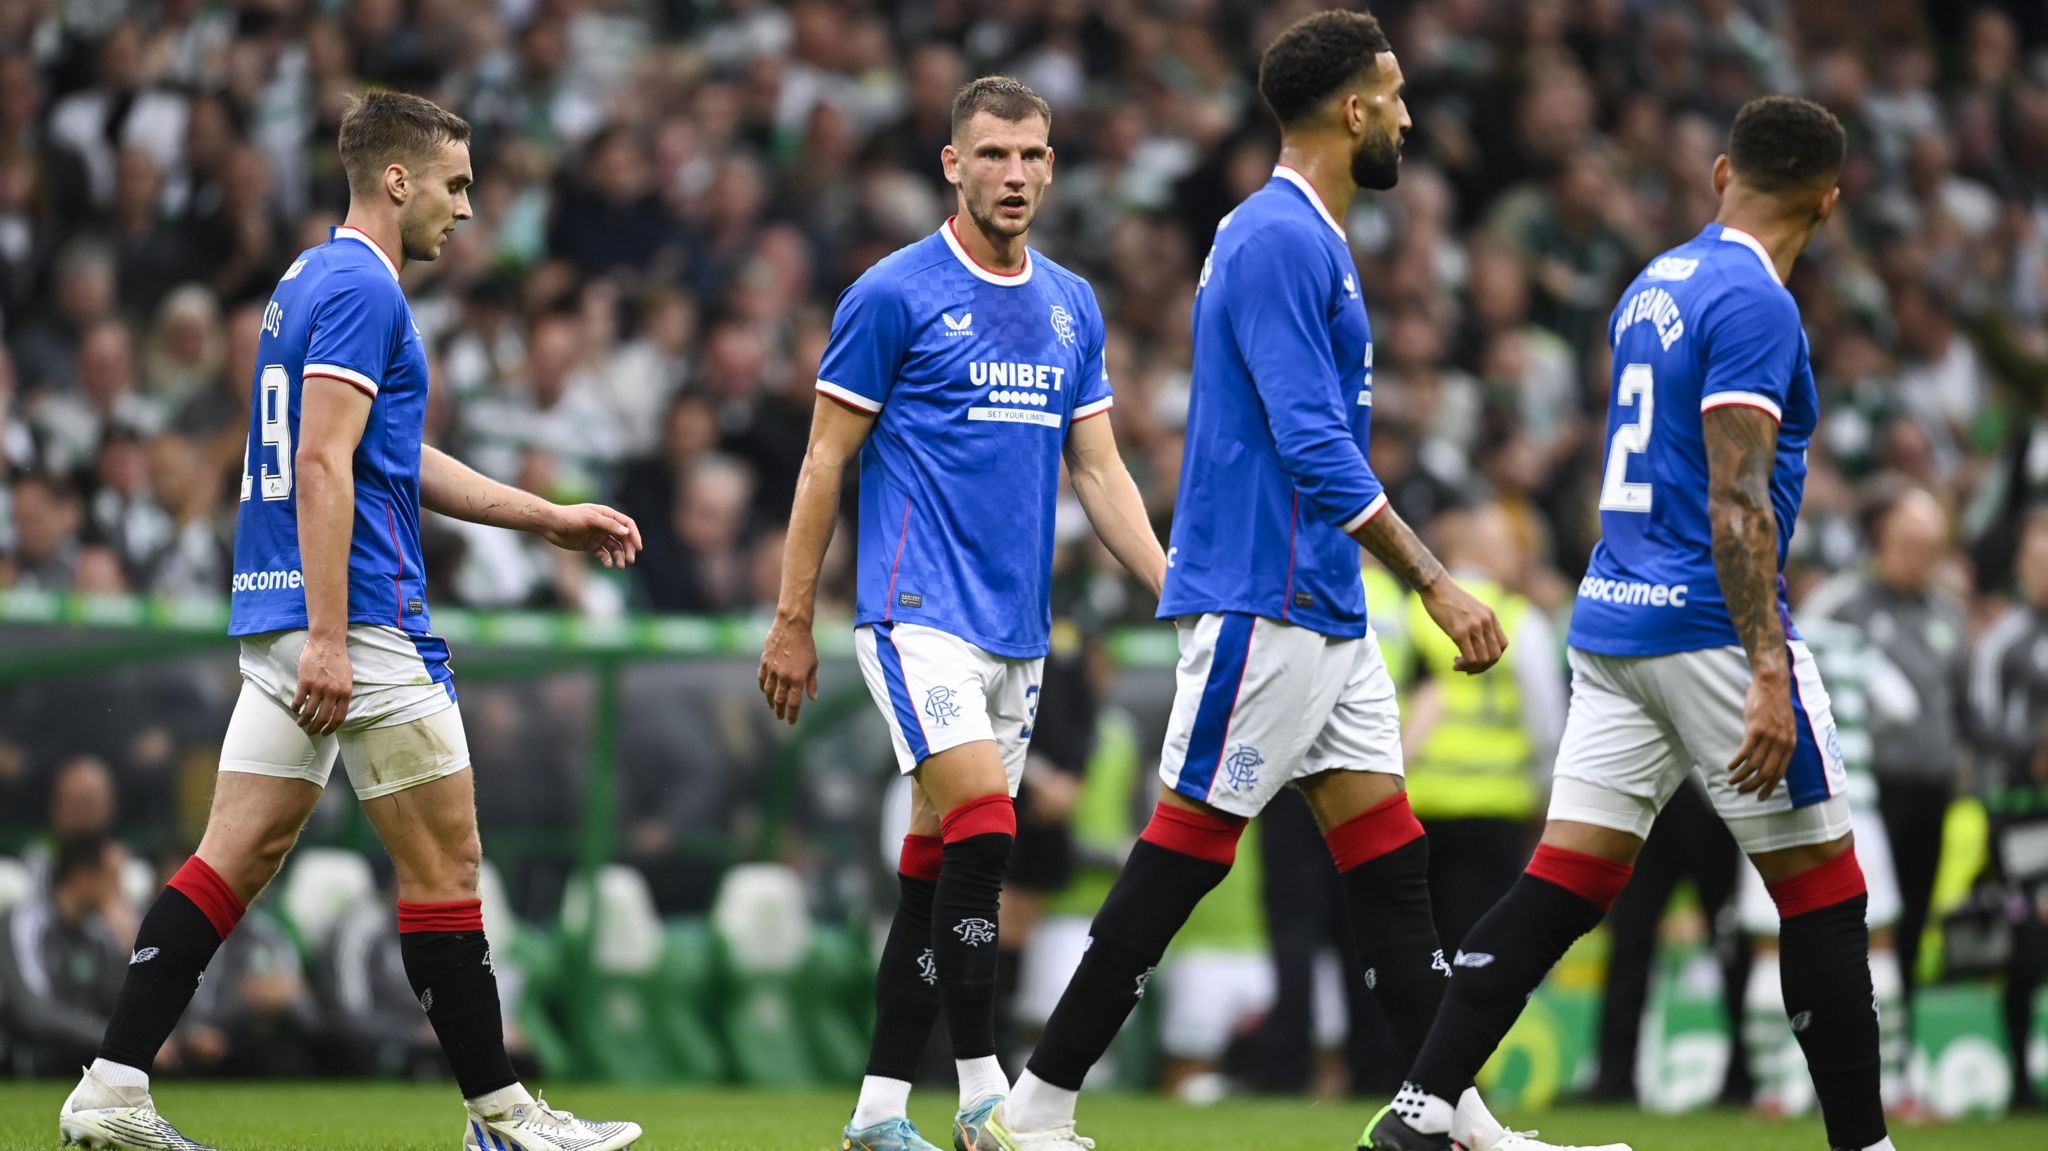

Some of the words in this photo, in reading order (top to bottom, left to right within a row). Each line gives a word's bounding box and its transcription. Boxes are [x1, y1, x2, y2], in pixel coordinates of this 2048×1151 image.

[969, 362, 1065, 391] UNIBET
[987, 410, 1002, 418] SET
[1004, 411, 1024, 419] YOUR
[1599, 363, 1654, 513] 2
[232, 570, 304, 593] socome
